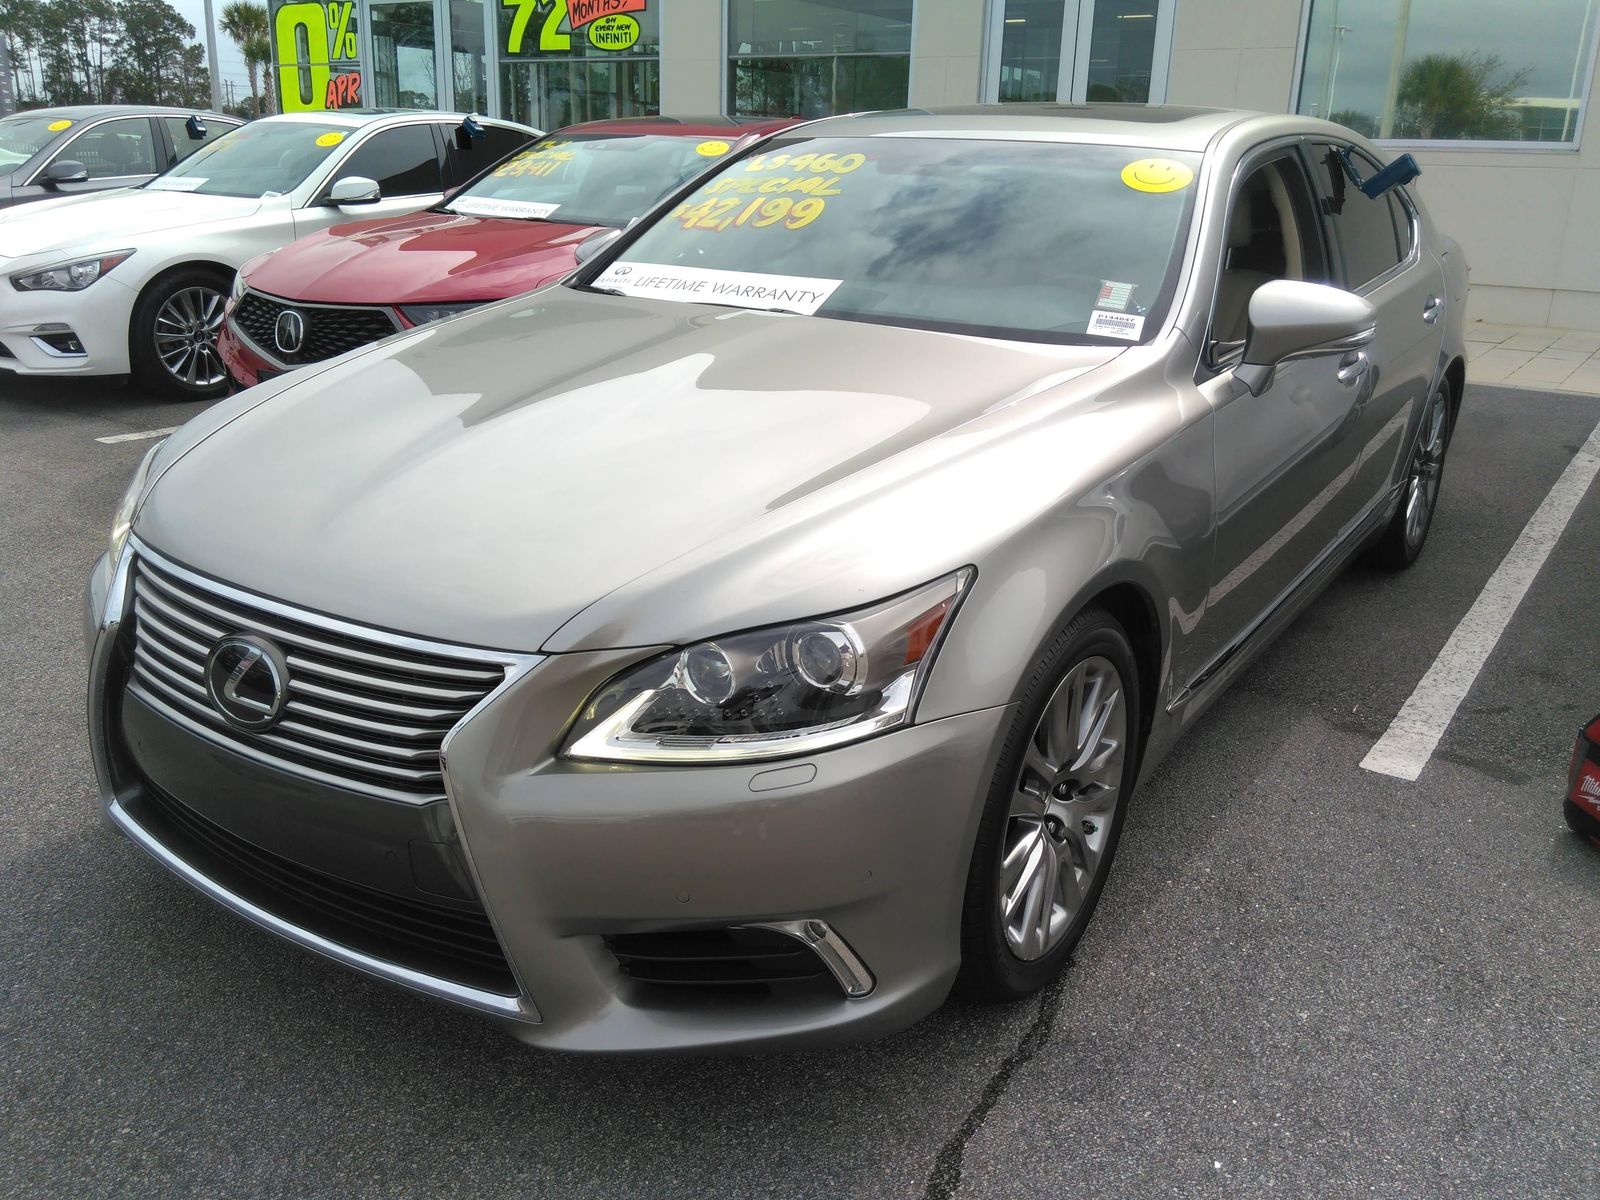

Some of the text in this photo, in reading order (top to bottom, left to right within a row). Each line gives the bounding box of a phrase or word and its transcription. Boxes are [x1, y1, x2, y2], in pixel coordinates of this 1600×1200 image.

[501, 0, 571, 54] 72
[596, 32, 632, 43] INFINITI
[275, 1, 357, 114] 0%
[325, 71, 361, 111] APR
[704, 176, 842, 196] SPECIAL
[500, 204, 551, 215] WARRANTY
[633, 276, 824, 303] LIFETIME WARRANTY
